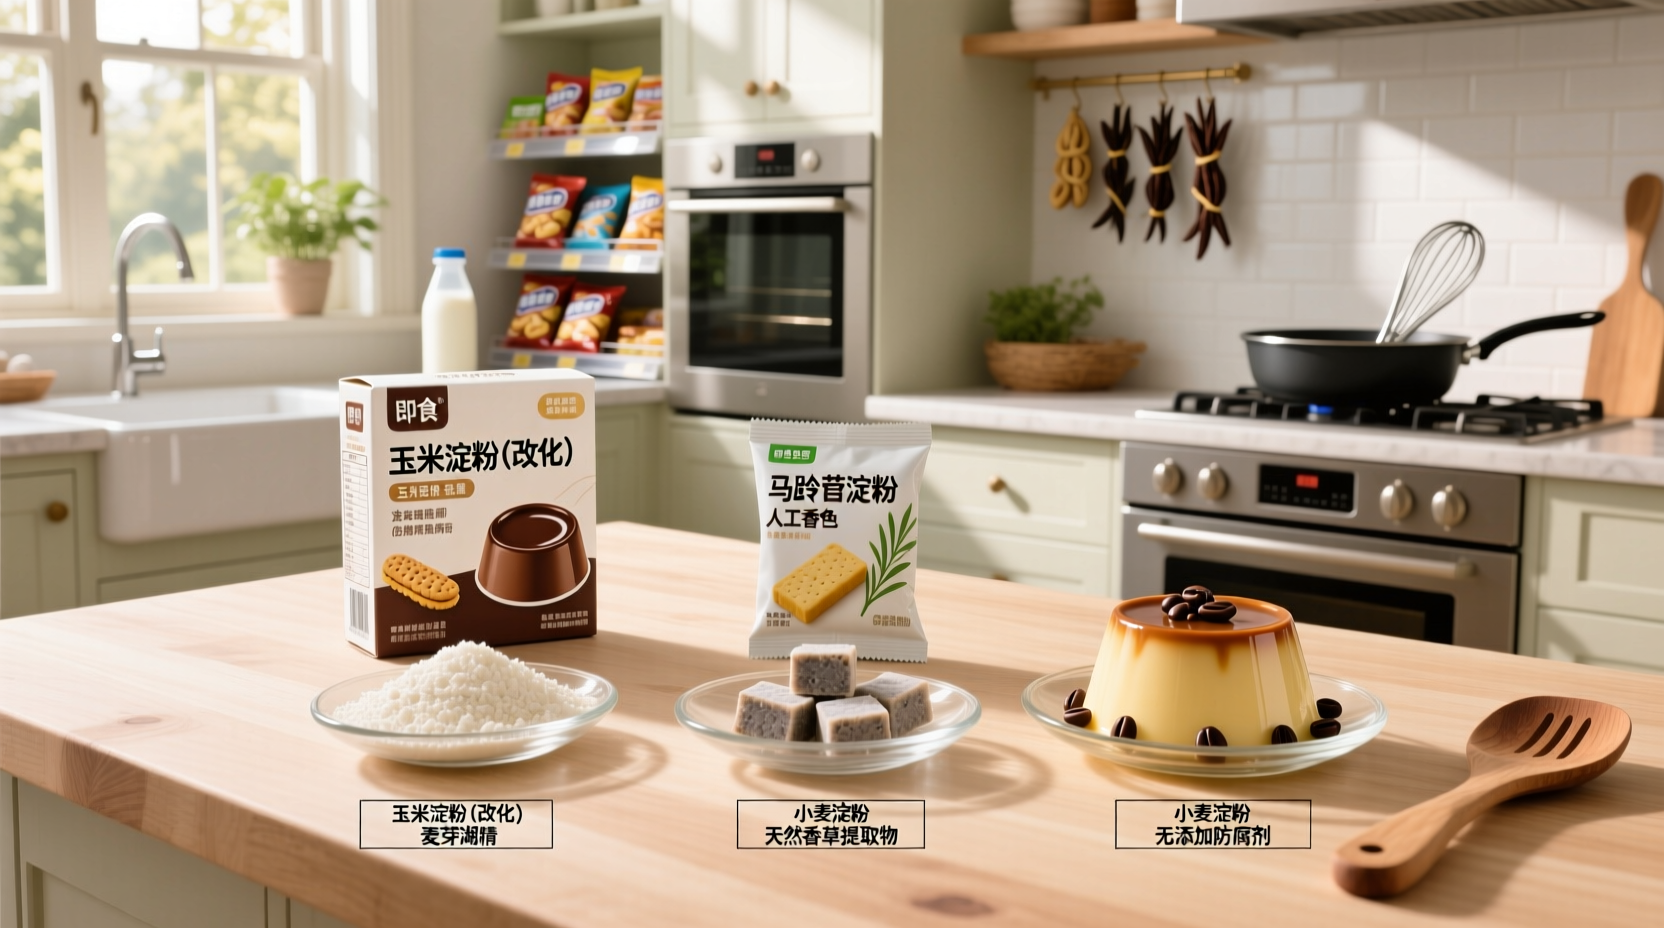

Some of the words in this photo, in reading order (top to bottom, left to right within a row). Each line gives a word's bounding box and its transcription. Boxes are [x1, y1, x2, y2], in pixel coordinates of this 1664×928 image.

[395, 396, 438, 424] 即食
[388, 436, 573, 475] 玉米淀粉(改化)
[766, 508, 839, 529] 人工香色
